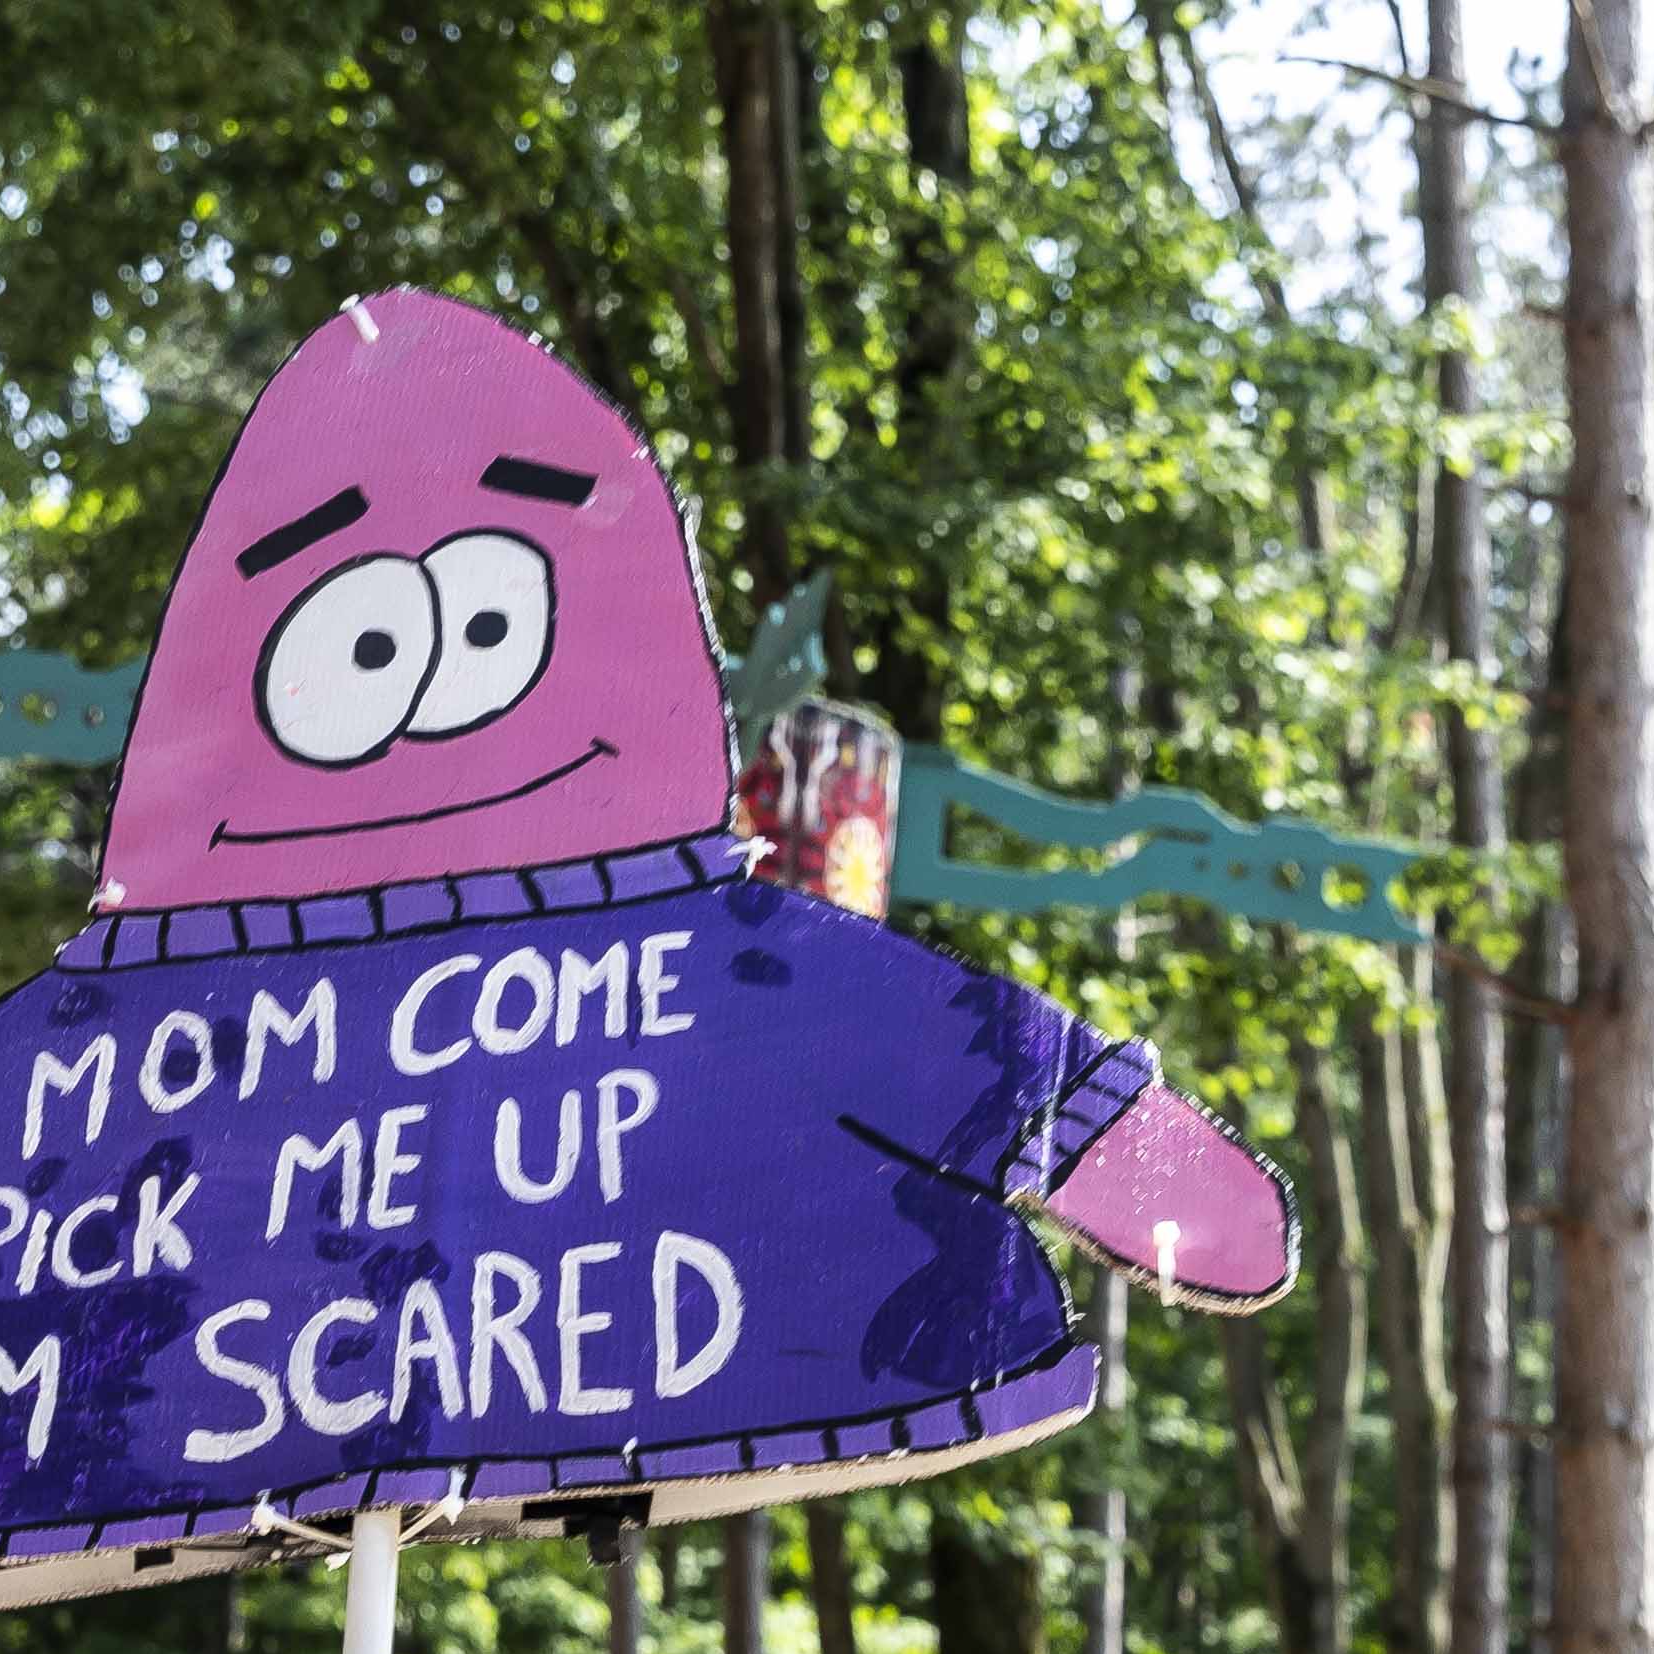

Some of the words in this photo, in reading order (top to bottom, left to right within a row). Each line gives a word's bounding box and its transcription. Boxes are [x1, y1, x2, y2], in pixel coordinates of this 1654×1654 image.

[21, 976, 338, 1161] MOM
[389, 930, 696, 1076] COME
[264, 1103, 428, 1242] ME
[493, 1068, 659, 1204] UP
[182, 1230, 745, 1464] SCARED
